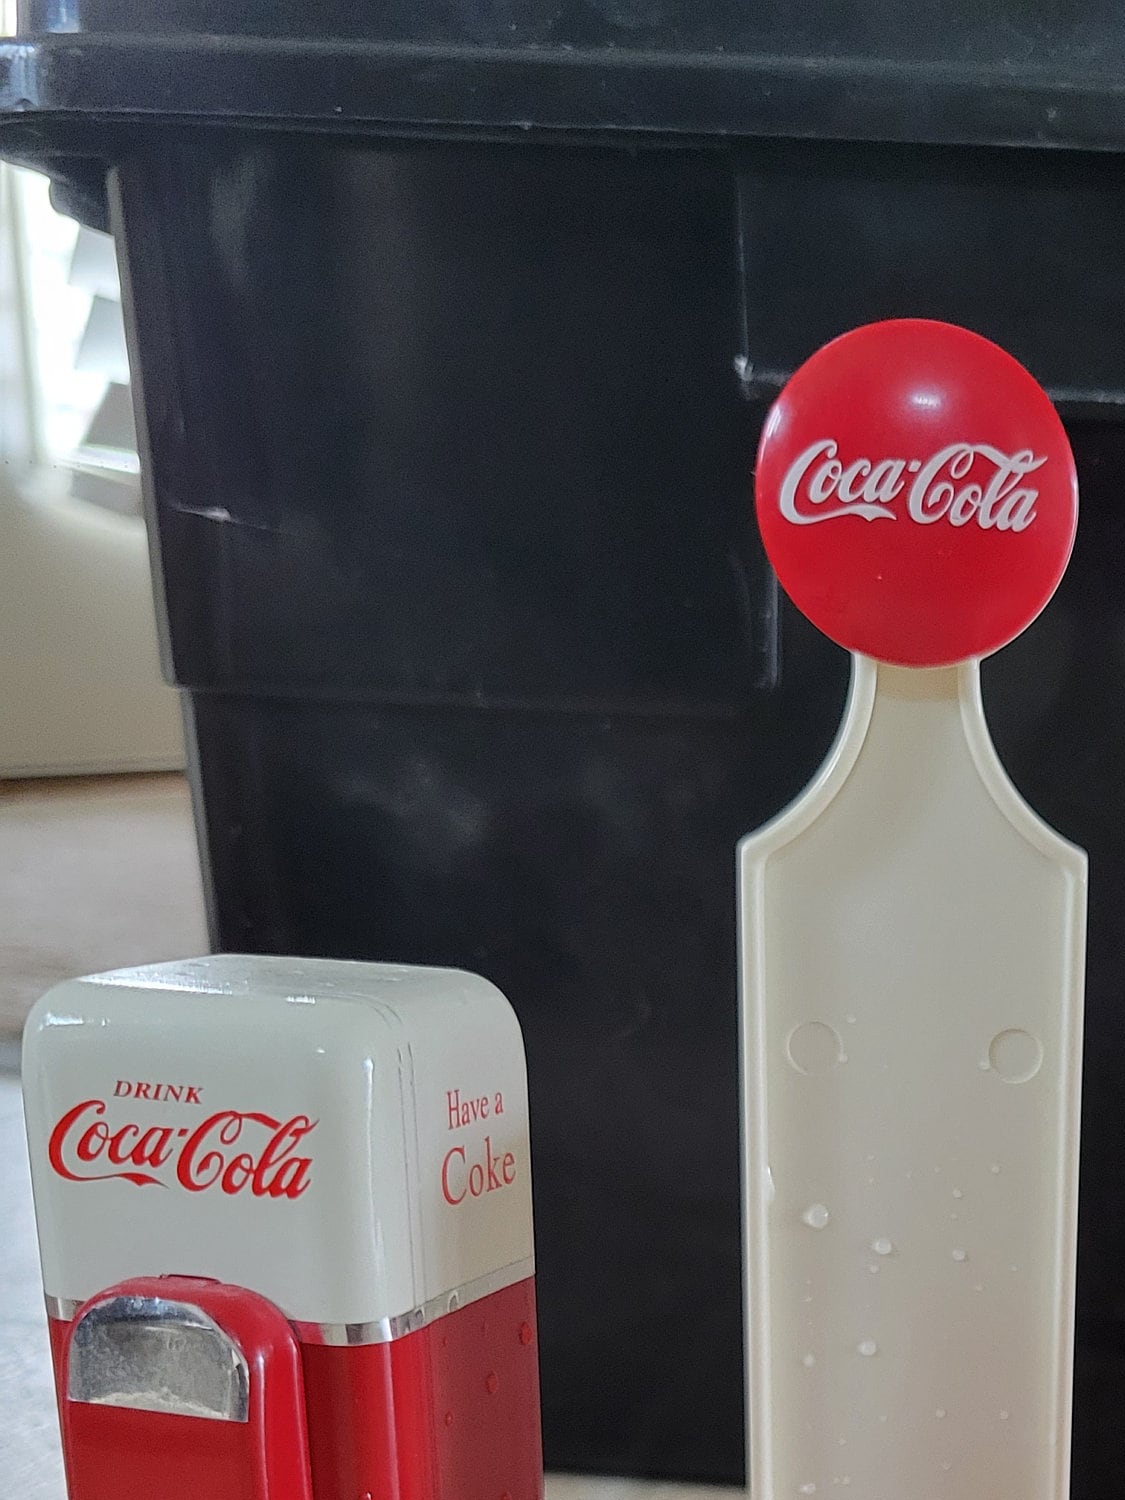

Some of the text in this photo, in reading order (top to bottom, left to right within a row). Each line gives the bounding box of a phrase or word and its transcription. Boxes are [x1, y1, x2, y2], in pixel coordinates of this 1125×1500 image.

[779, 439, 1048, 532] Coca-Cola
[113, 1080, 205, 1105] DRINK
[446, 1090, 504, 1130] Have a
[48, 1099, 320, 1200] Coca-Cola
[441, 1136, 516, 1206] Coke
